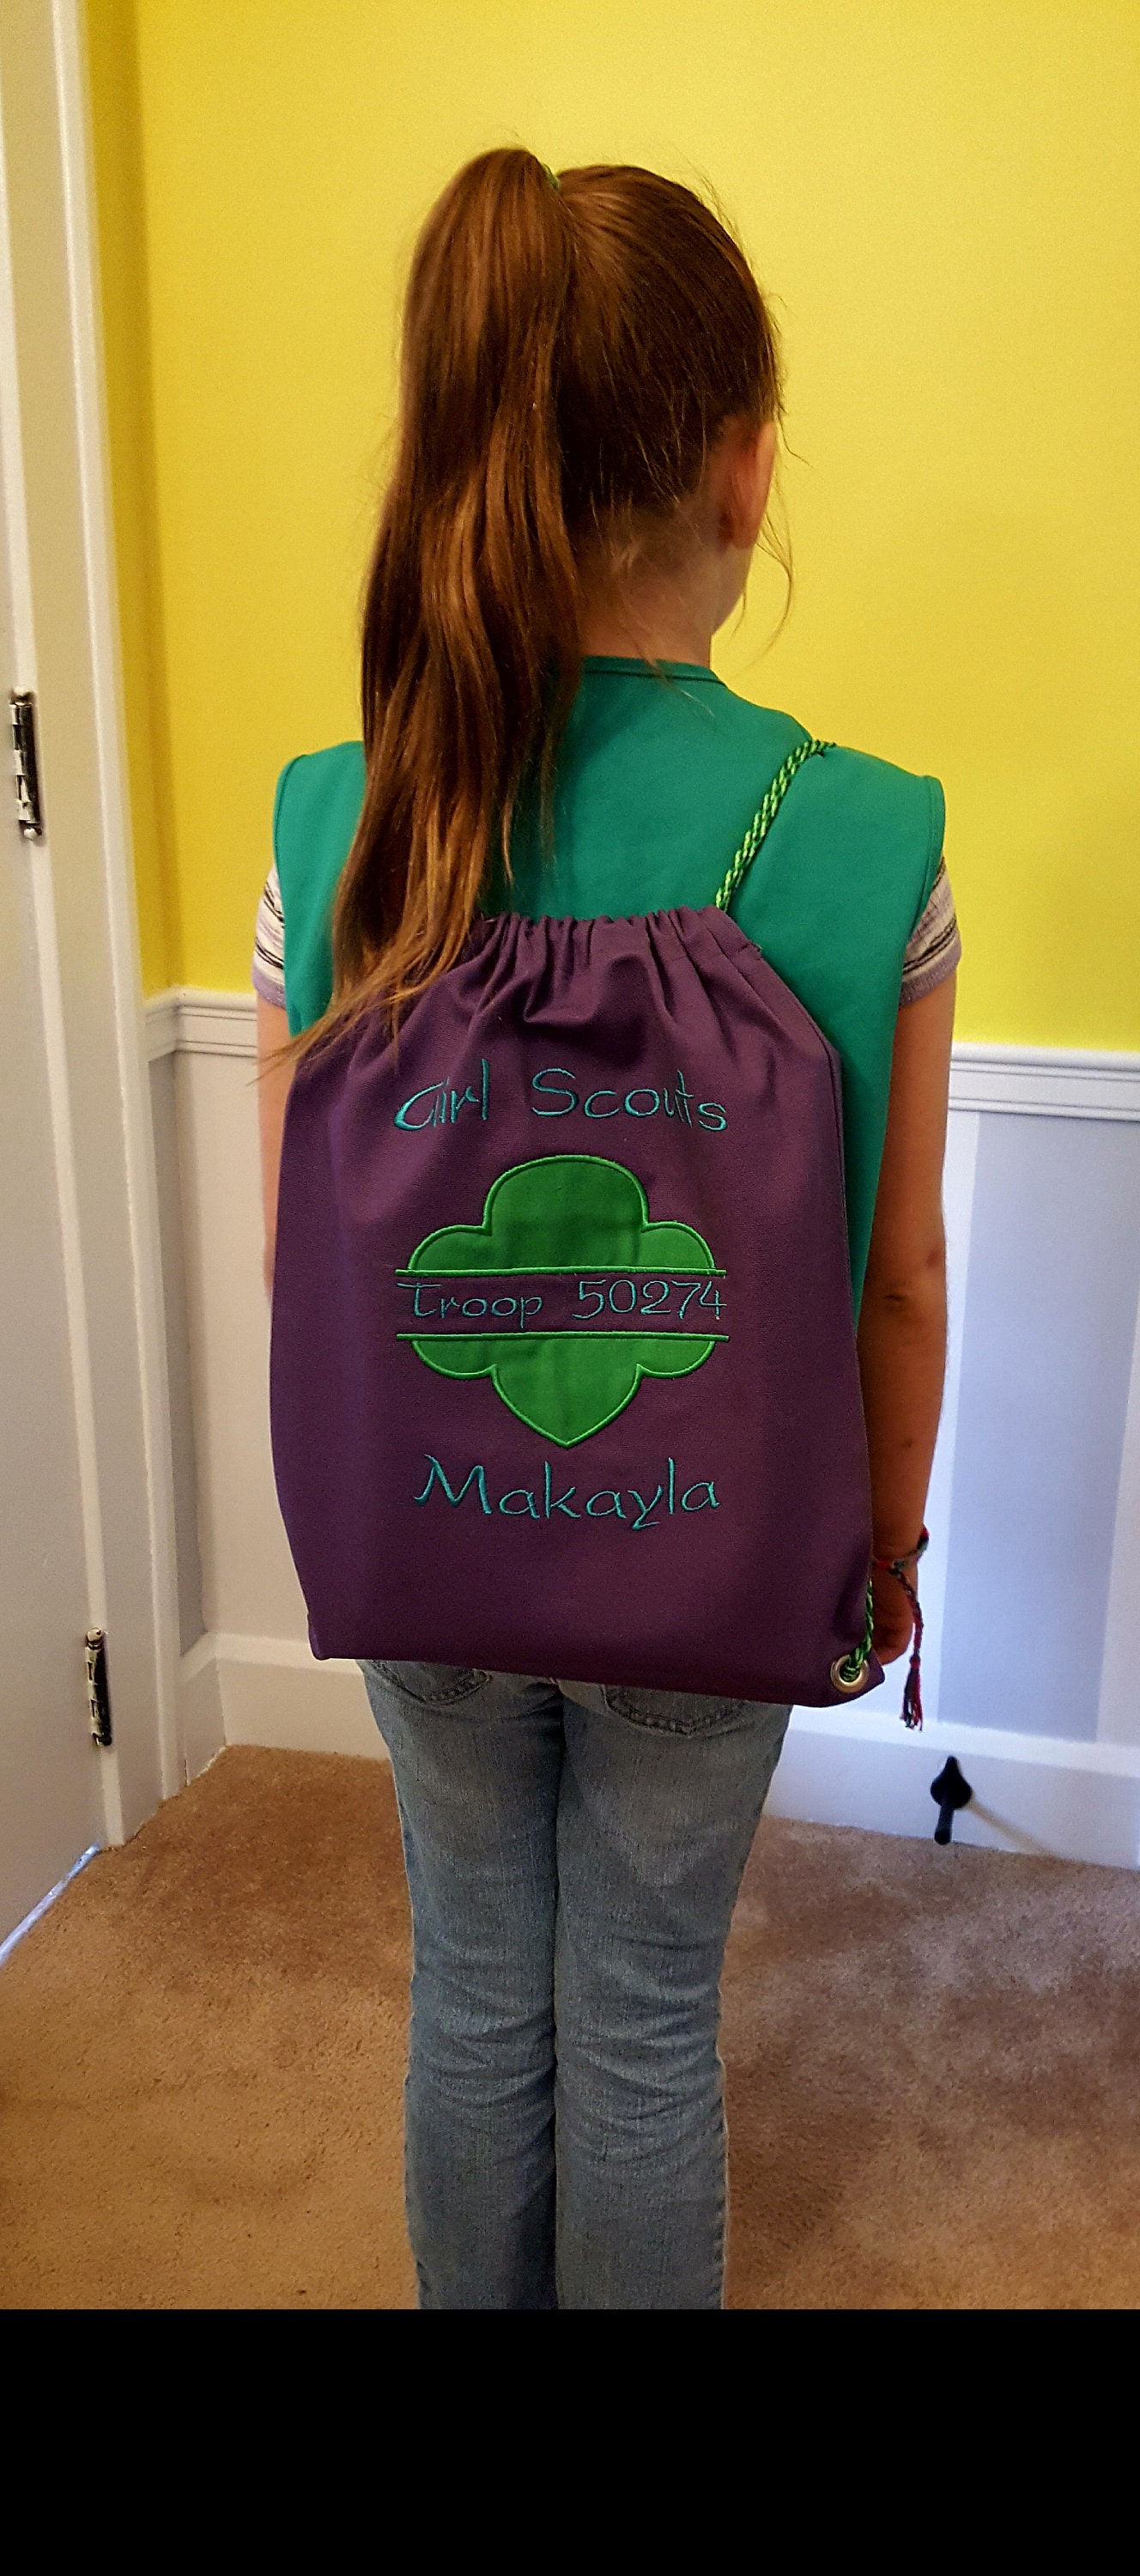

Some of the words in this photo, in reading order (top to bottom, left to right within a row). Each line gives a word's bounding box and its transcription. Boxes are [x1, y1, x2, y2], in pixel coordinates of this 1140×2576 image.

[393, 1058, 490, 1132] Girl
[531, 1067, 729, 1133] Scouts
[395, 1281, 544, 1329] Troop
[571, 1279, 728, 1321] 50274
[413, 1453, 721, 1531] Makayla
